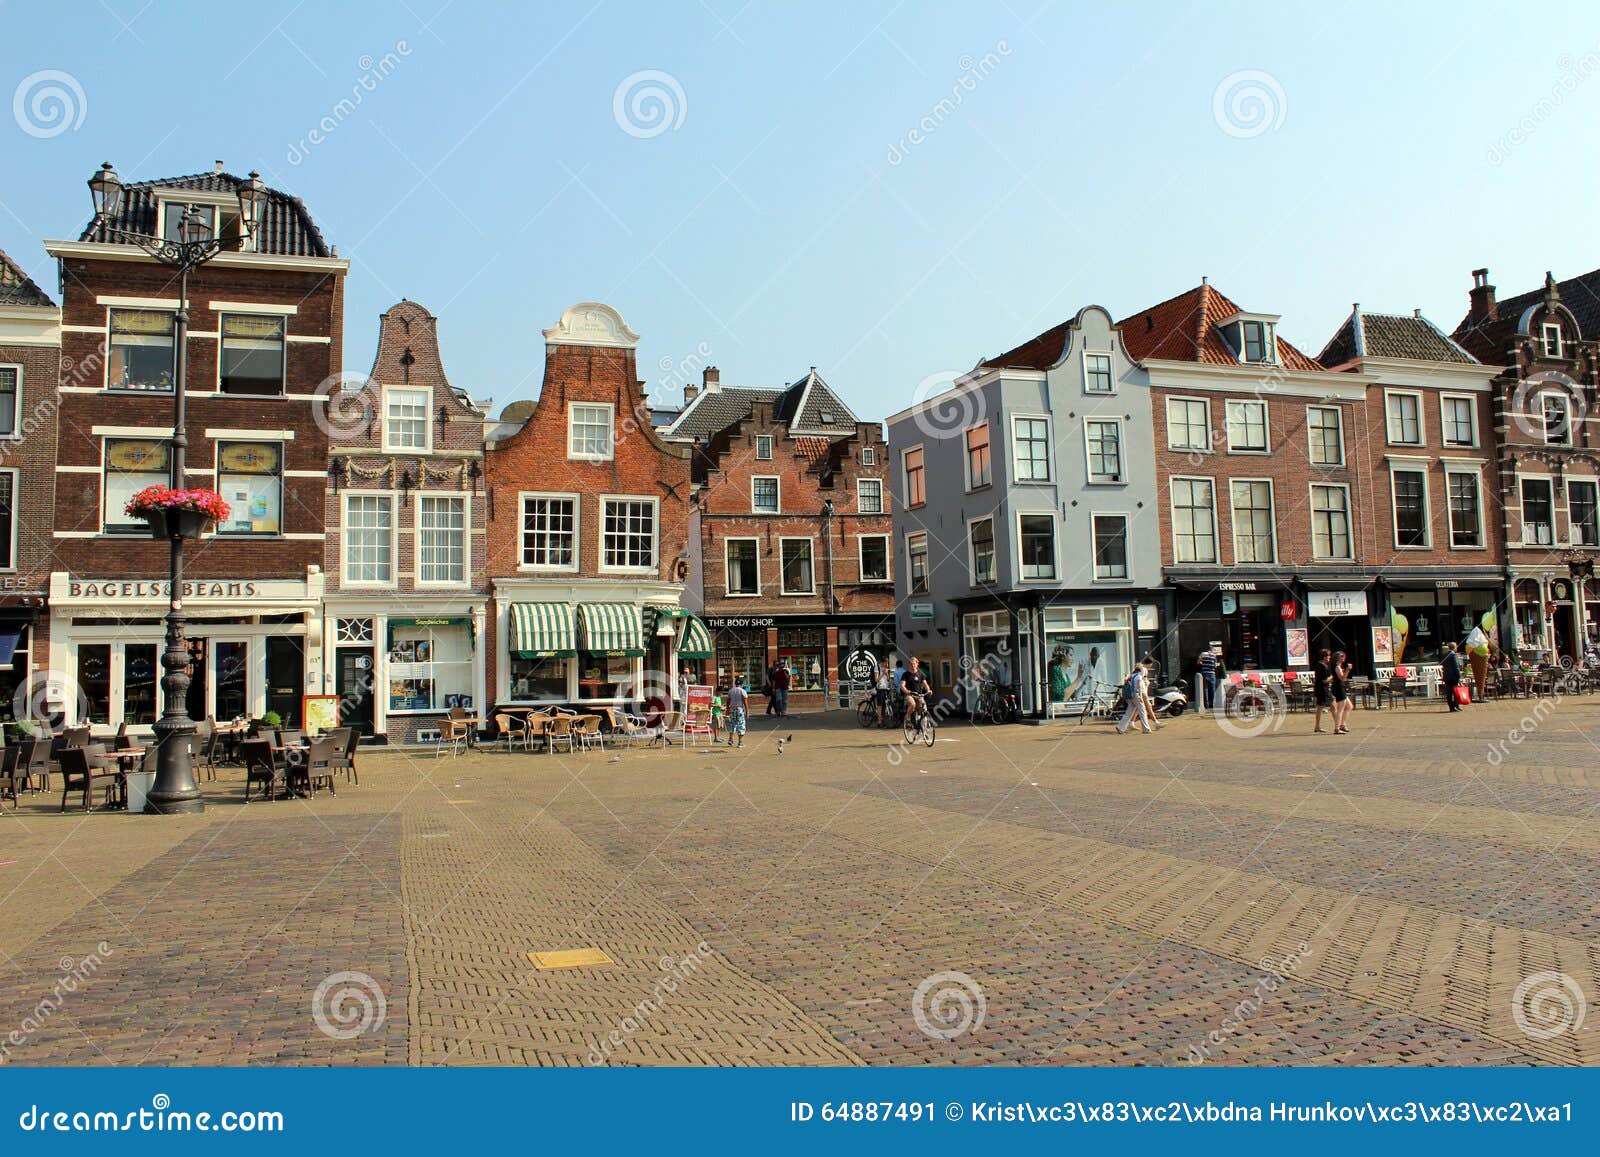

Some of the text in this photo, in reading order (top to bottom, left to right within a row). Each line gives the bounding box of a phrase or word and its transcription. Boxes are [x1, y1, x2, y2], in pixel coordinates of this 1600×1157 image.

[70, 583, 160, 597] BAGELS
[182, 583, 256, 597] BEANS
[1219, 583, 1257, 591] ESPRESSO BAR
[1281, 603, 1294, 618] illy
[708, 619, 725, 627] THE
[727, 619, 751, 627] BODY
